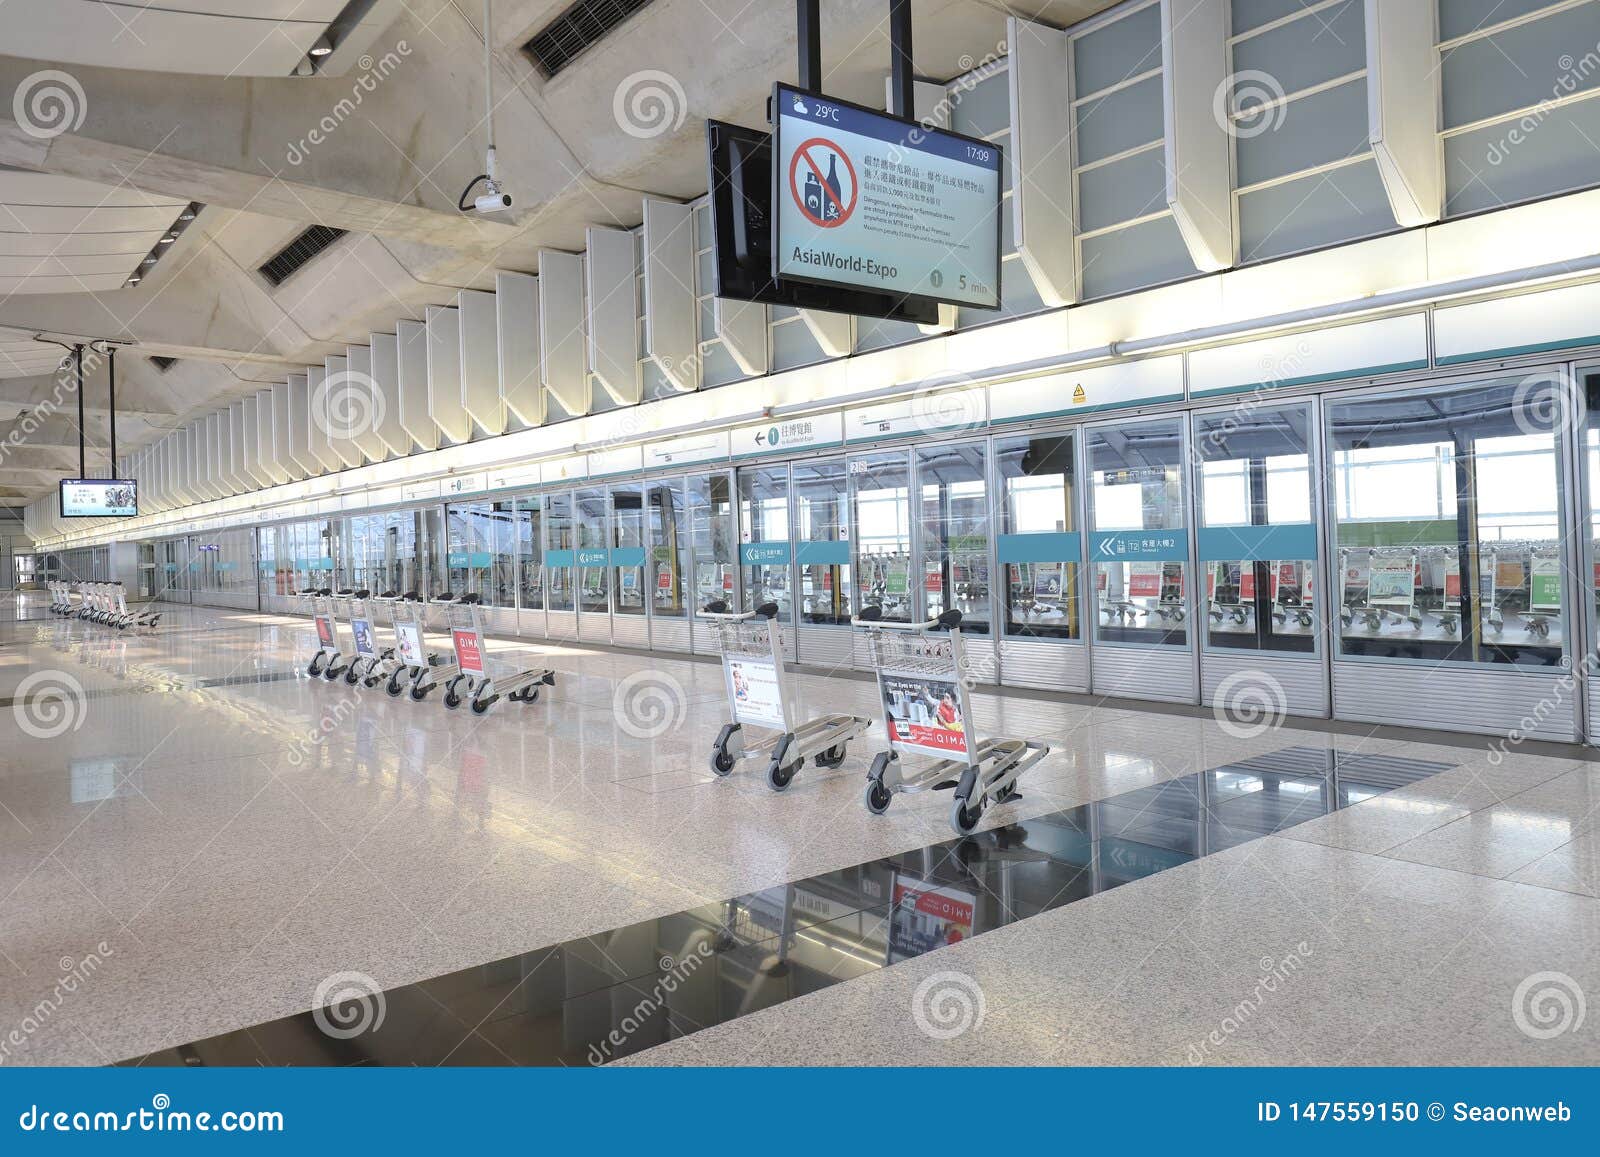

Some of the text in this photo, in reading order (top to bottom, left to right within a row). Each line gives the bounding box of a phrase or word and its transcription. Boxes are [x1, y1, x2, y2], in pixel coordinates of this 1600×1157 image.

[815, 103, 840, 122] 29°C
[967, 146, 989, 162] 17:09
[792, 246, 898, 281] AsiaWorld-Expo
[959, 275, 967, 290] 5
[971, 281, 988, 294] min
[936, 734, 966, 746] QIMA
